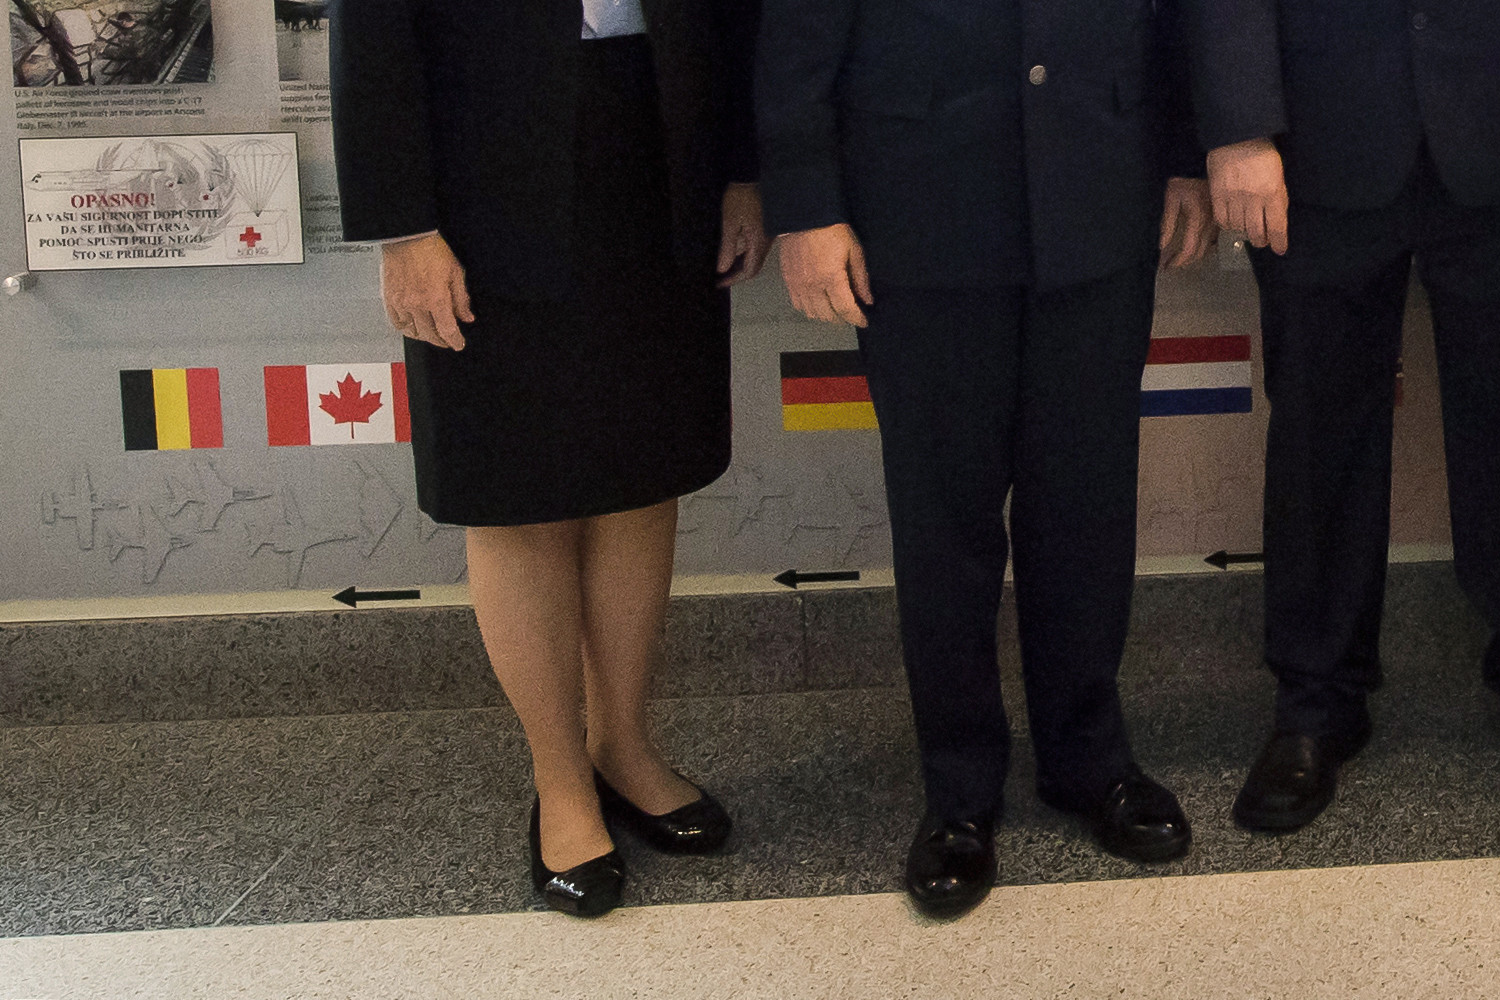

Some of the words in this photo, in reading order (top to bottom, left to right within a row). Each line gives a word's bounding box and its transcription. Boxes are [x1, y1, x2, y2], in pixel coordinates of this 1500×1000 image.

[70, 193, 155, 209] OPASNO!
[27, 213, 42, 223] ZA
[81, 210, 150, 221] SIGURNOST
[153, 208, 219, 220] DOPUSTITE
[60, 224, 77, 235] DA
[80, 224, 96, 234] SE
[98, 222, 190, 234] HUMANITARNA
[87, 236, 128, 246] SPUSTI
[131, 234, 163, 246] PRIJE
[168, 233, 203, 244] NEGO
[72, 248, 96, 260] ŠTO
[100, 249, 113, 259] SE
[117, 247, 186, 259] PRIBLIŽITE
